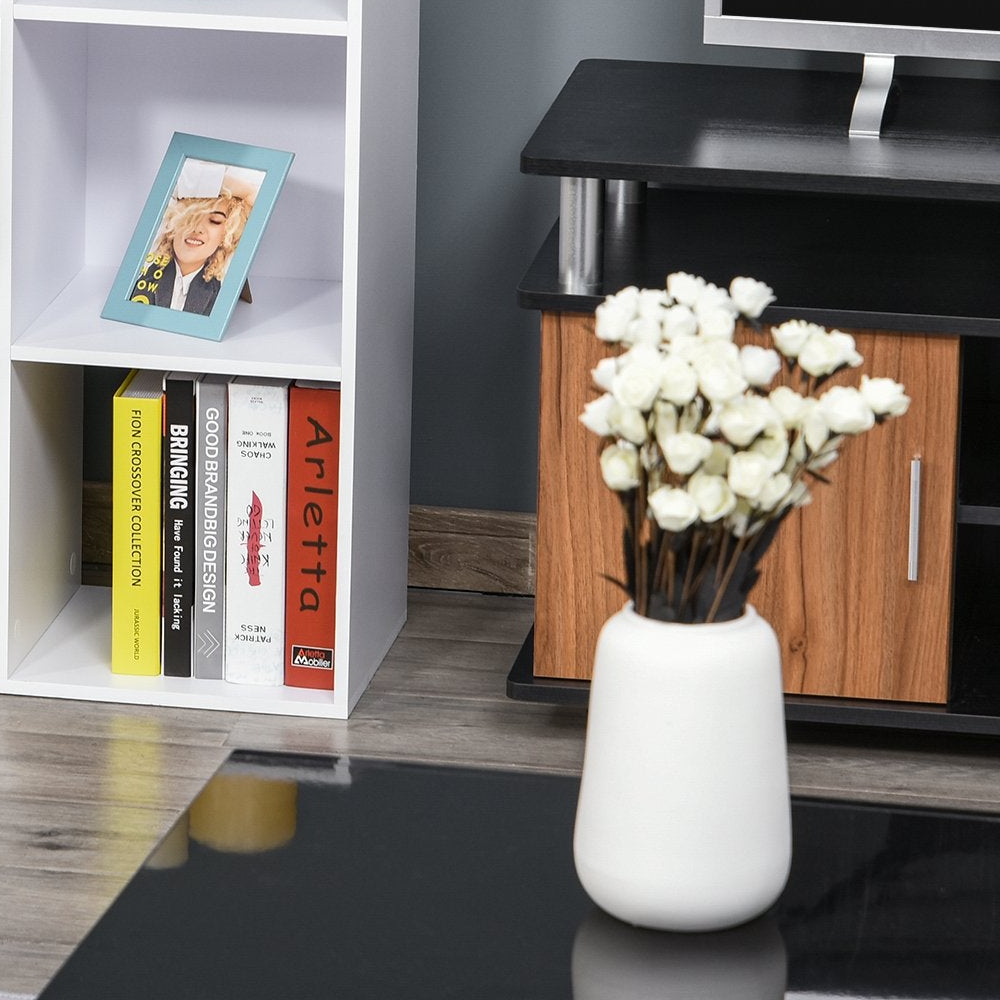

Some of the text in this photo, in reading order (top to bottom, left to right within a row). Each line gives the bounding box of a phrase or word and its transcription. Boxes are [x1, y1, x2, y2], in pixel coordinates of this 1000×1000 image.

[236, 440, 276, 449] WALKING
[240, 451, 272, 459] CHAOS
[130, 409, 141, 587] FION CROSSOVER COLLECTION
[299, 415, 334, 613] Arletta
[169, 424, 189, 630] BRINGING Have Found it lacking
[240, 624, 266, 632] NESS
[234, 634, 272, 642] PATRICK
